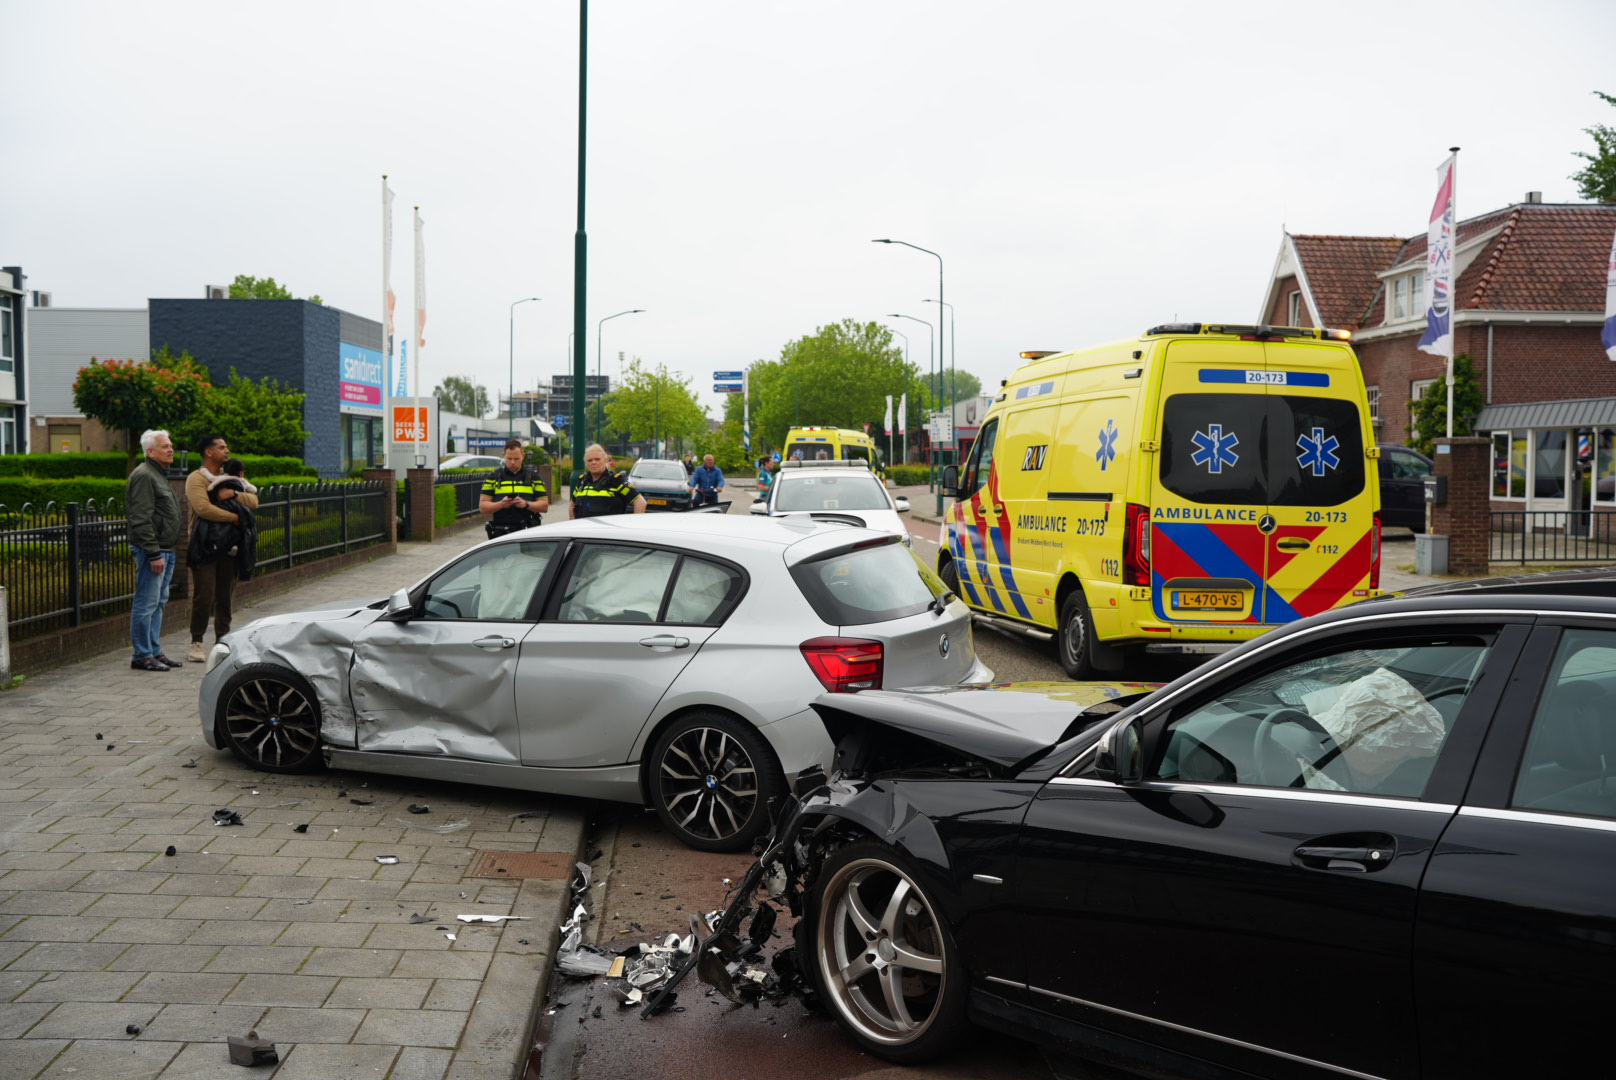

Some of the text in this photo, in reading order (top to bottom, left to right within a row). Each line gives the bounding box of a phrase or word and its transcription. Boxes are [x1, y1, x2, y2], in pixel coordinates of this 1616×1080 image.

[344, 352, 382, 385] sanidirect
[1248, 372, 1284, 383] 20-173
[395, 428, 425, 439] PWS
[1022, 445, 1048, 470] RAV
[1153, 507, 1347, 523] AMBULANCE 20-173
[1017, 514, 1105, 536] AMBULANCE 20-173
[1183, 594, 1238, 606] L-470-VS
